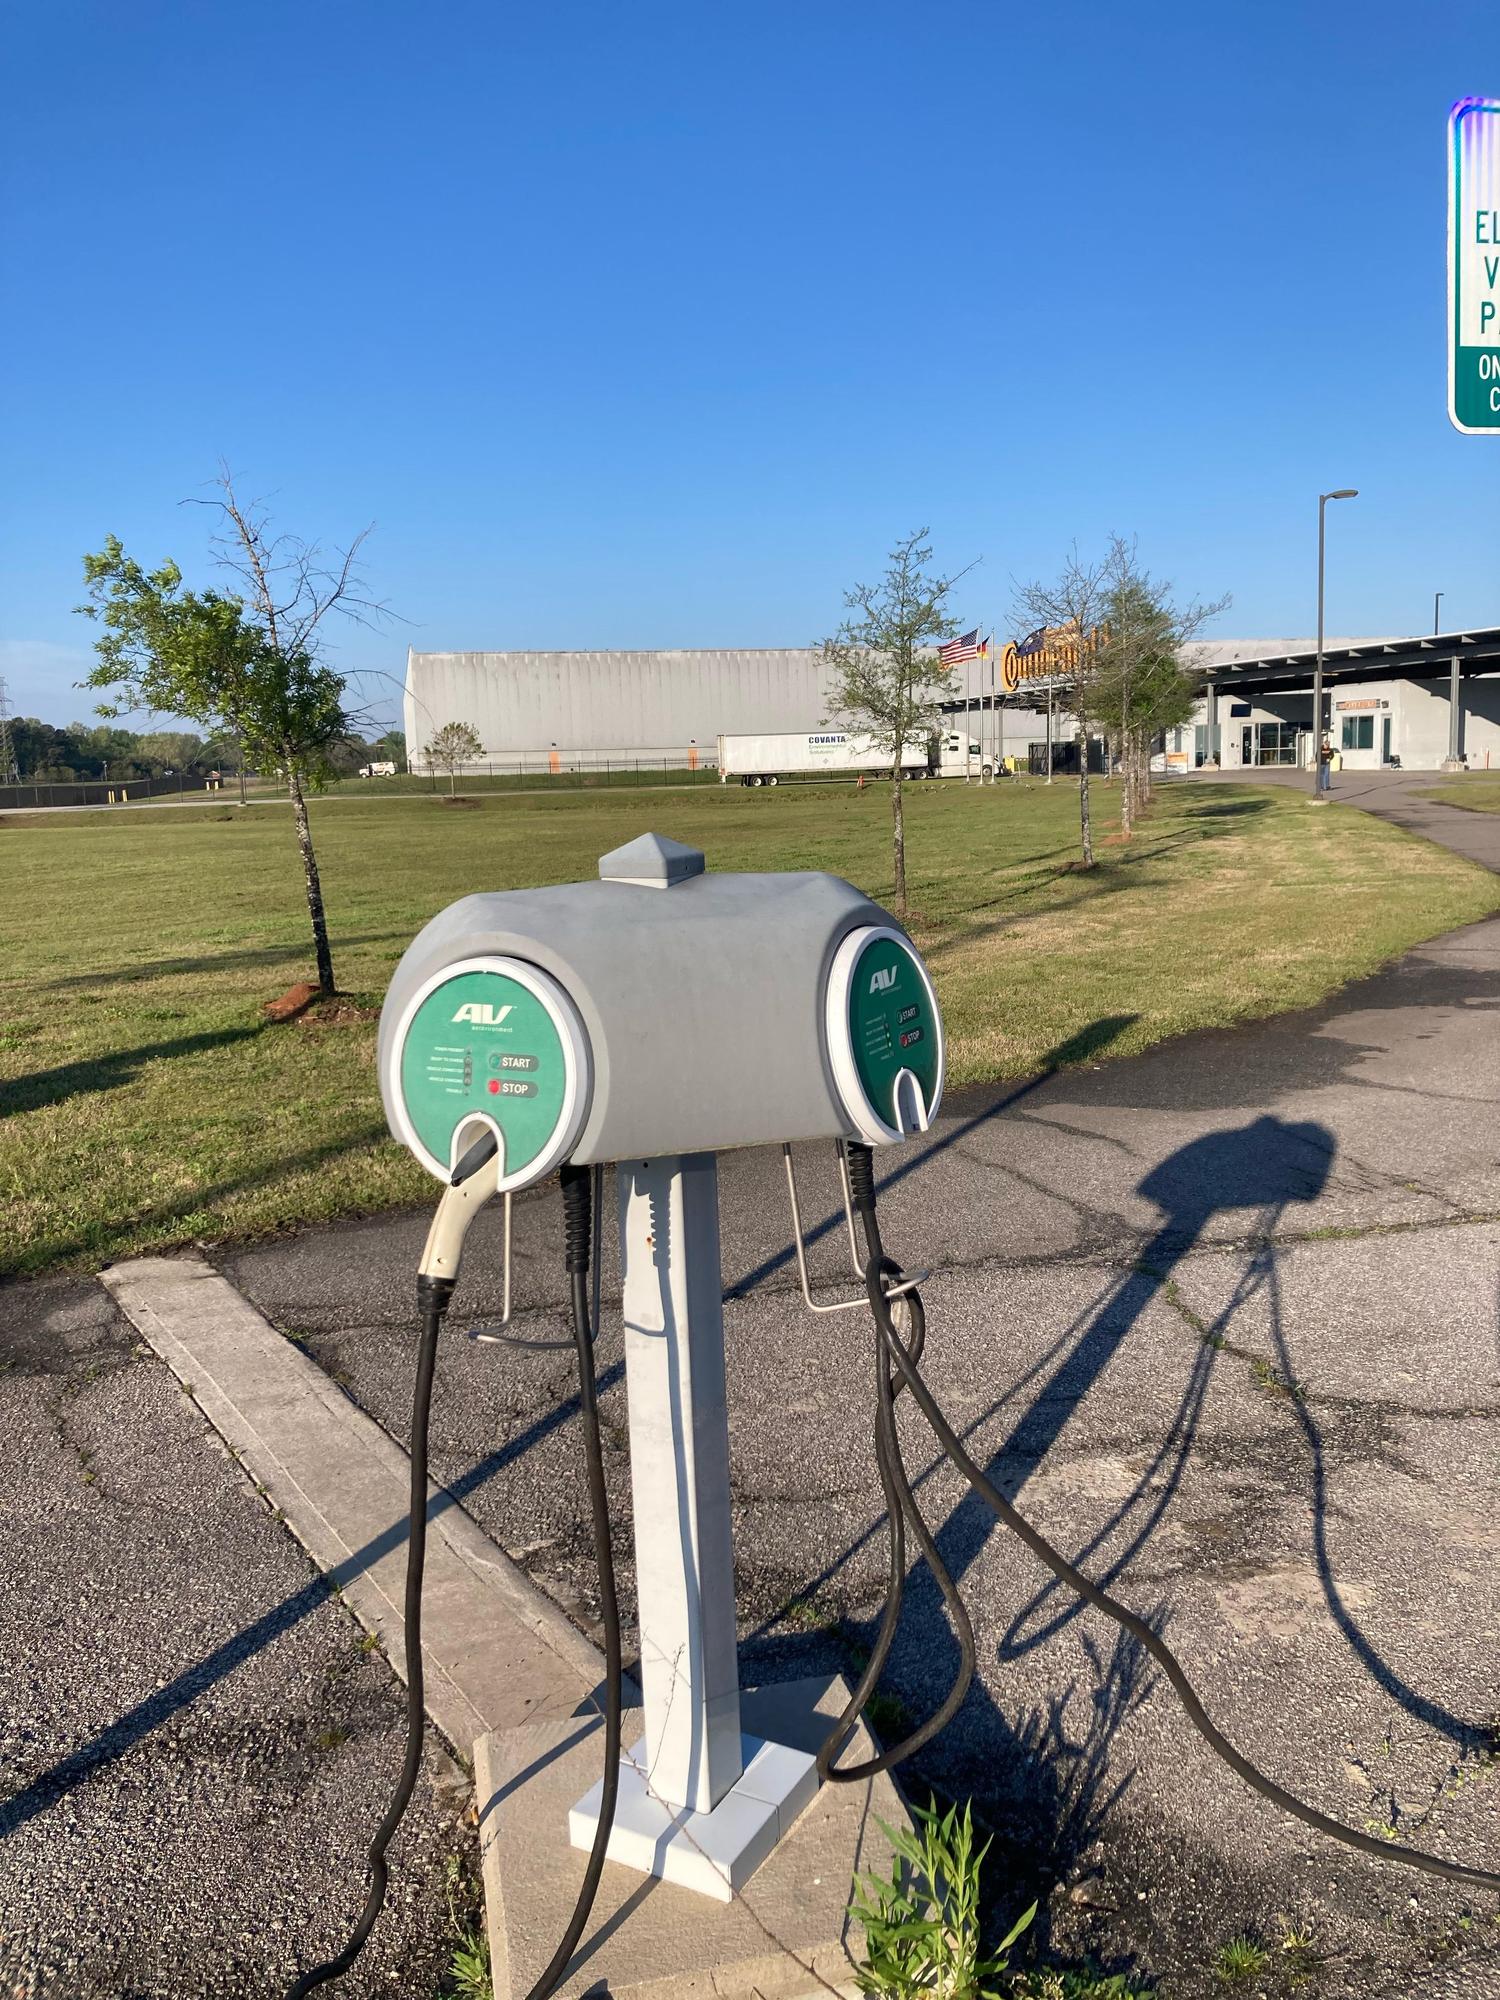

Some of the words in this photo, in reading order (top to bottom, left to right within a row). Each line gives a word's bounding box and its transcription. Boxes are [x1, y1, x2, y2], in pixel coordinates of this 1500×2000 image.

[1476, 210, 1500, 244] EL
[1484, 256, 1500, 290] V
[1481, 301, 1500, 335] P
[1479, 354, 1500, 380] ON
[808, 735, 846, 744] COVANTA
[868, 965, 898, 994] AV
[451, 1003, 513, 1025] AV
[902, 1007, 917, 1020] START
[907, 1030, 920, 1043] STOP
[502, 1056, 531, 1068] START
[502, 1082, 529, 1094] STOP
